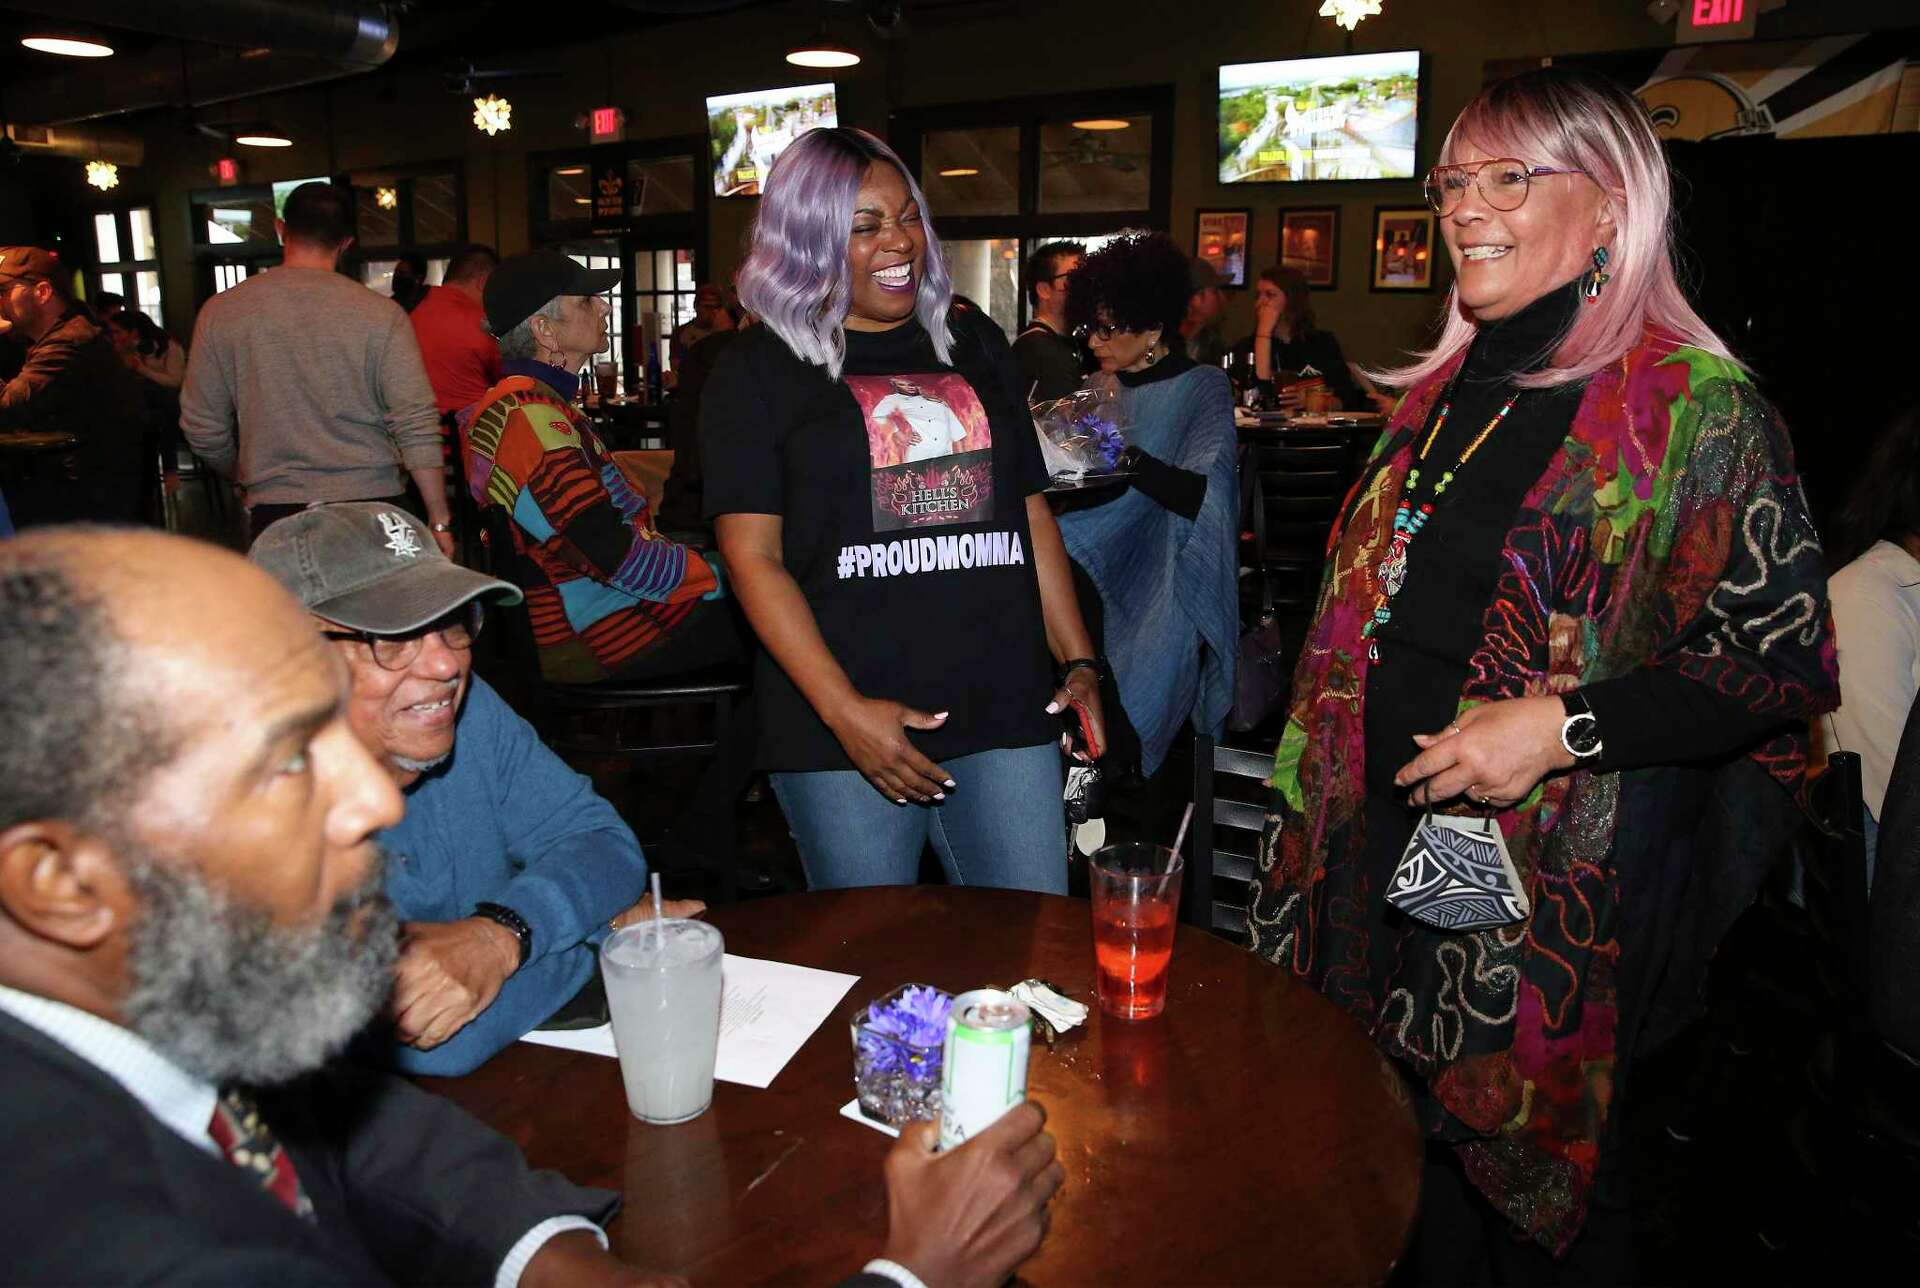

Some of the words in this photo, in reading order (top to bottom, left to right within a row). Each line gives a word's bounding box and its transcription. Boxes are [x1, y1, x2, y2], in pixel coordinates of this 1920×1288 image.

[1691, 0, 1744, 26] EXIT
[911, 487, 957, 502] HELL'S
[901, 498, 969, 516] KITCHEN
[837, 531, 1025, 579] #PROUDMOMMA
